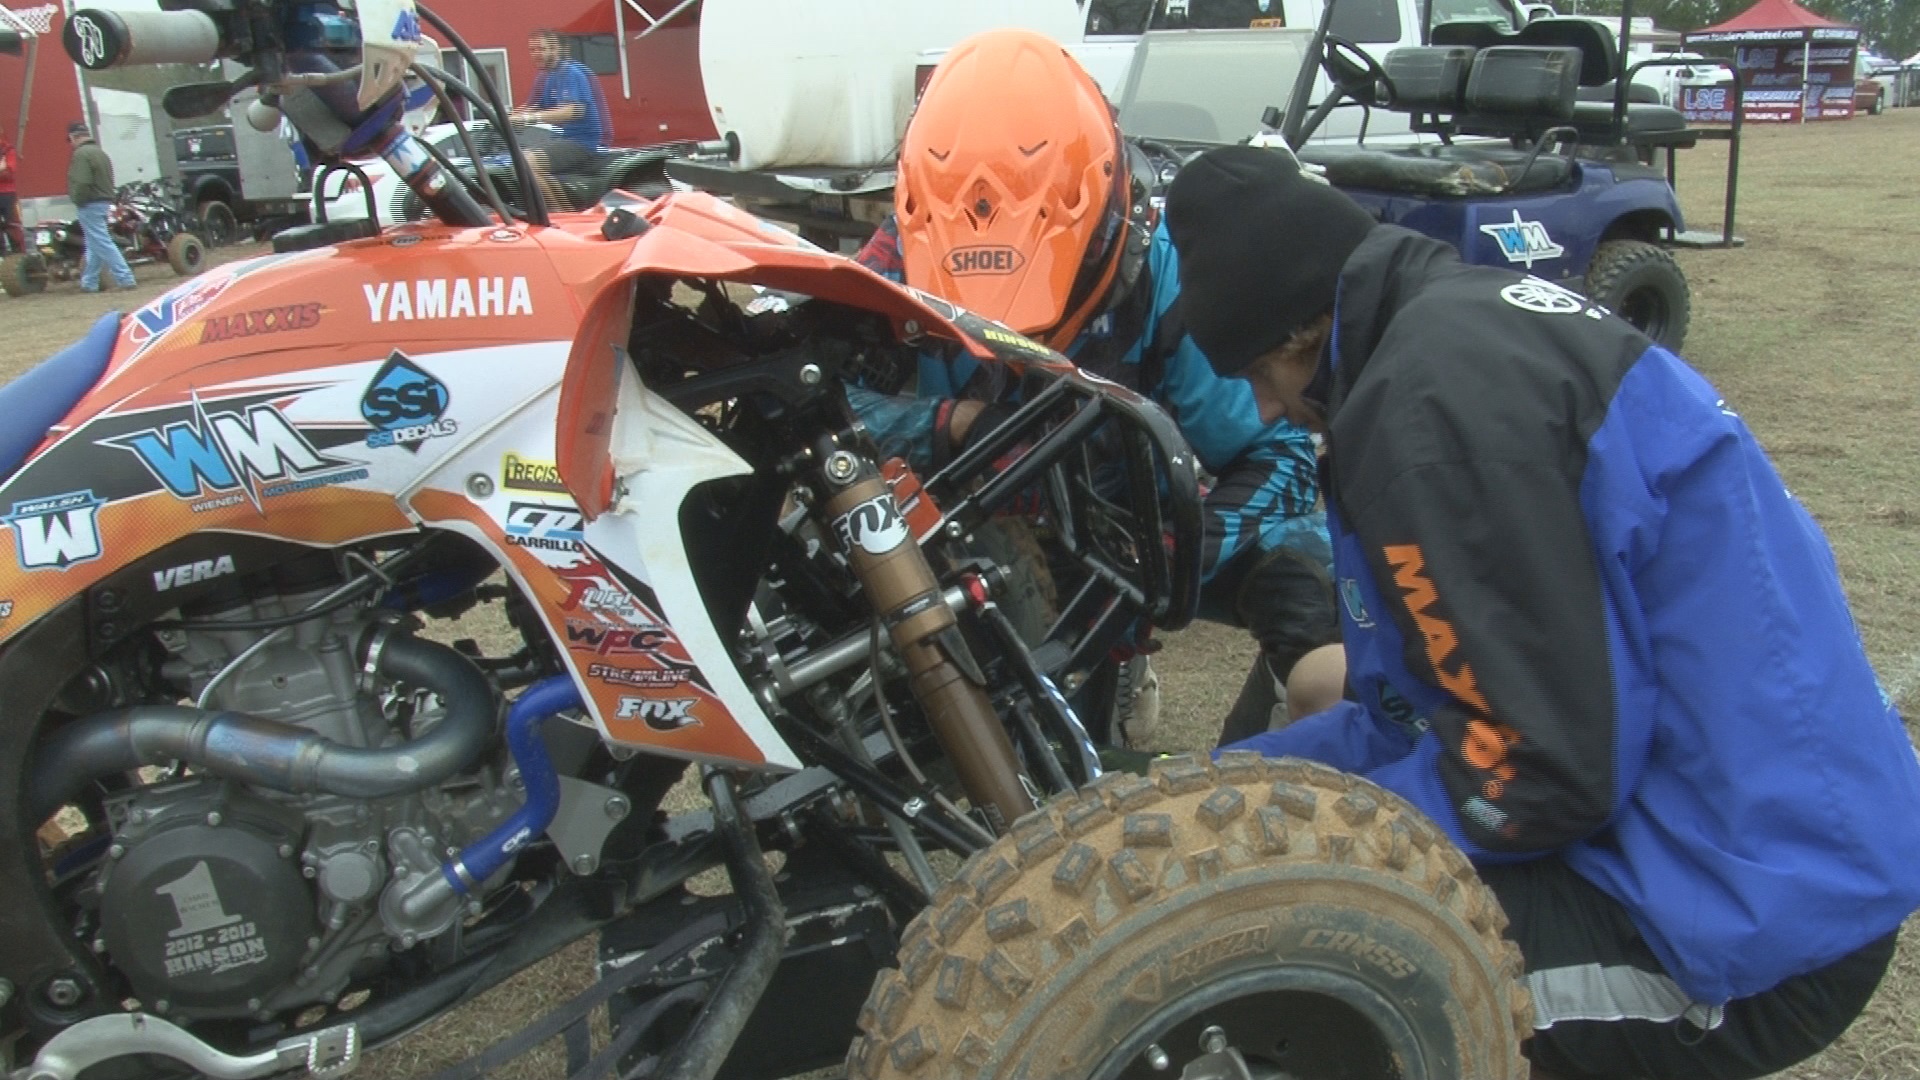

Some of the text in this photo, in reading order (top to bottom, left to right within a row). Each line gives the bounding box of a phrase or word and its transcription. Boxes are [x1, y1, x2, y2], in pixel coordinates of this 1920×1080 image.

[1683, 88, 1726, 110] LSE
[951, 250, 1013, 271] SHOEI
[362, 275, 534, 322] YAMAHA
[201, 303, 320, 344] MAXXIS
[112, 398, 338, 502] WM
[263, 468, 369, 498] MOTORSPORTS
[504, 453, 562, 484] PRECIS
[191, 494, 245, 513] WIENEN
[505, 534, 585, 553] CARRILLO
[153, 555, 236, 592] VERA
[588, 663, 691, 683] STREAMLINE
[615, 696, 703, 733] FOX
[155, 860, 242, 938] 1
[164, 937, 266, 977] HINSON
